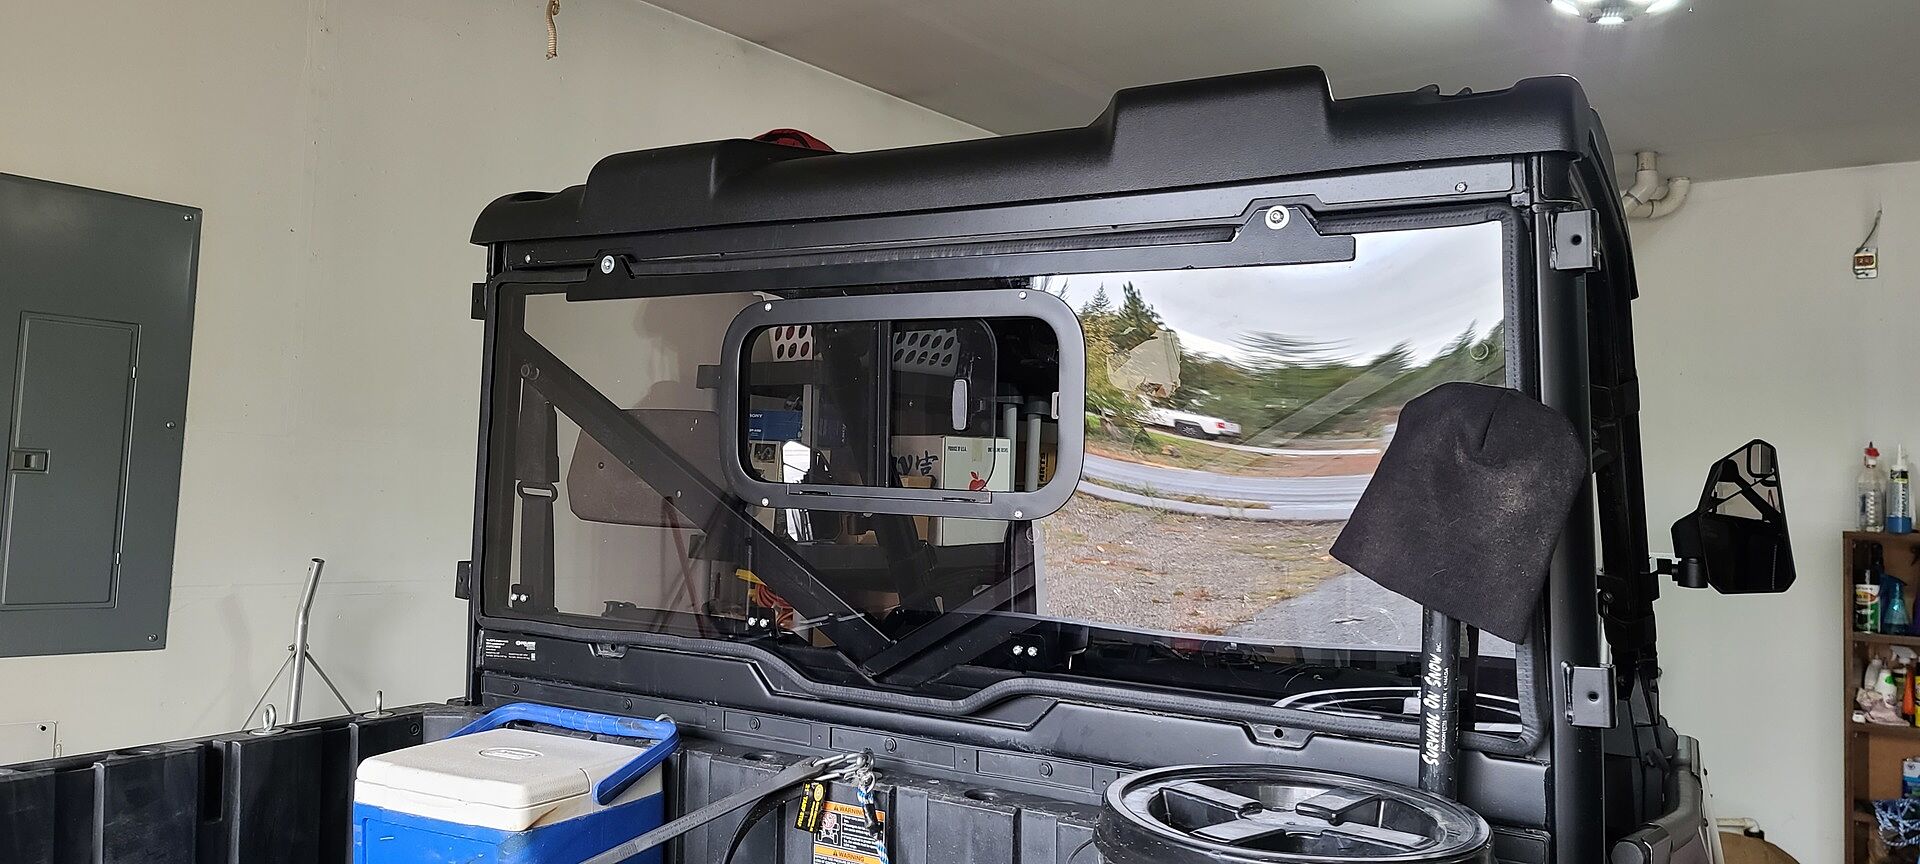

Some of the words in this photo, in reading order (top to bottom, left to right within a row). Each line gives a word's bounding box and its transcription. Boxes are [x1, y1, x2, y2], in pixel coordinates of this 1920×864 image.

[1424, 652, 1443, 688] SNOW
[1423, 690, 1441, 709] ON
[1421, 712, 1441, 767] SURVIVAL
[838, 851, 864, 862] WARNING
